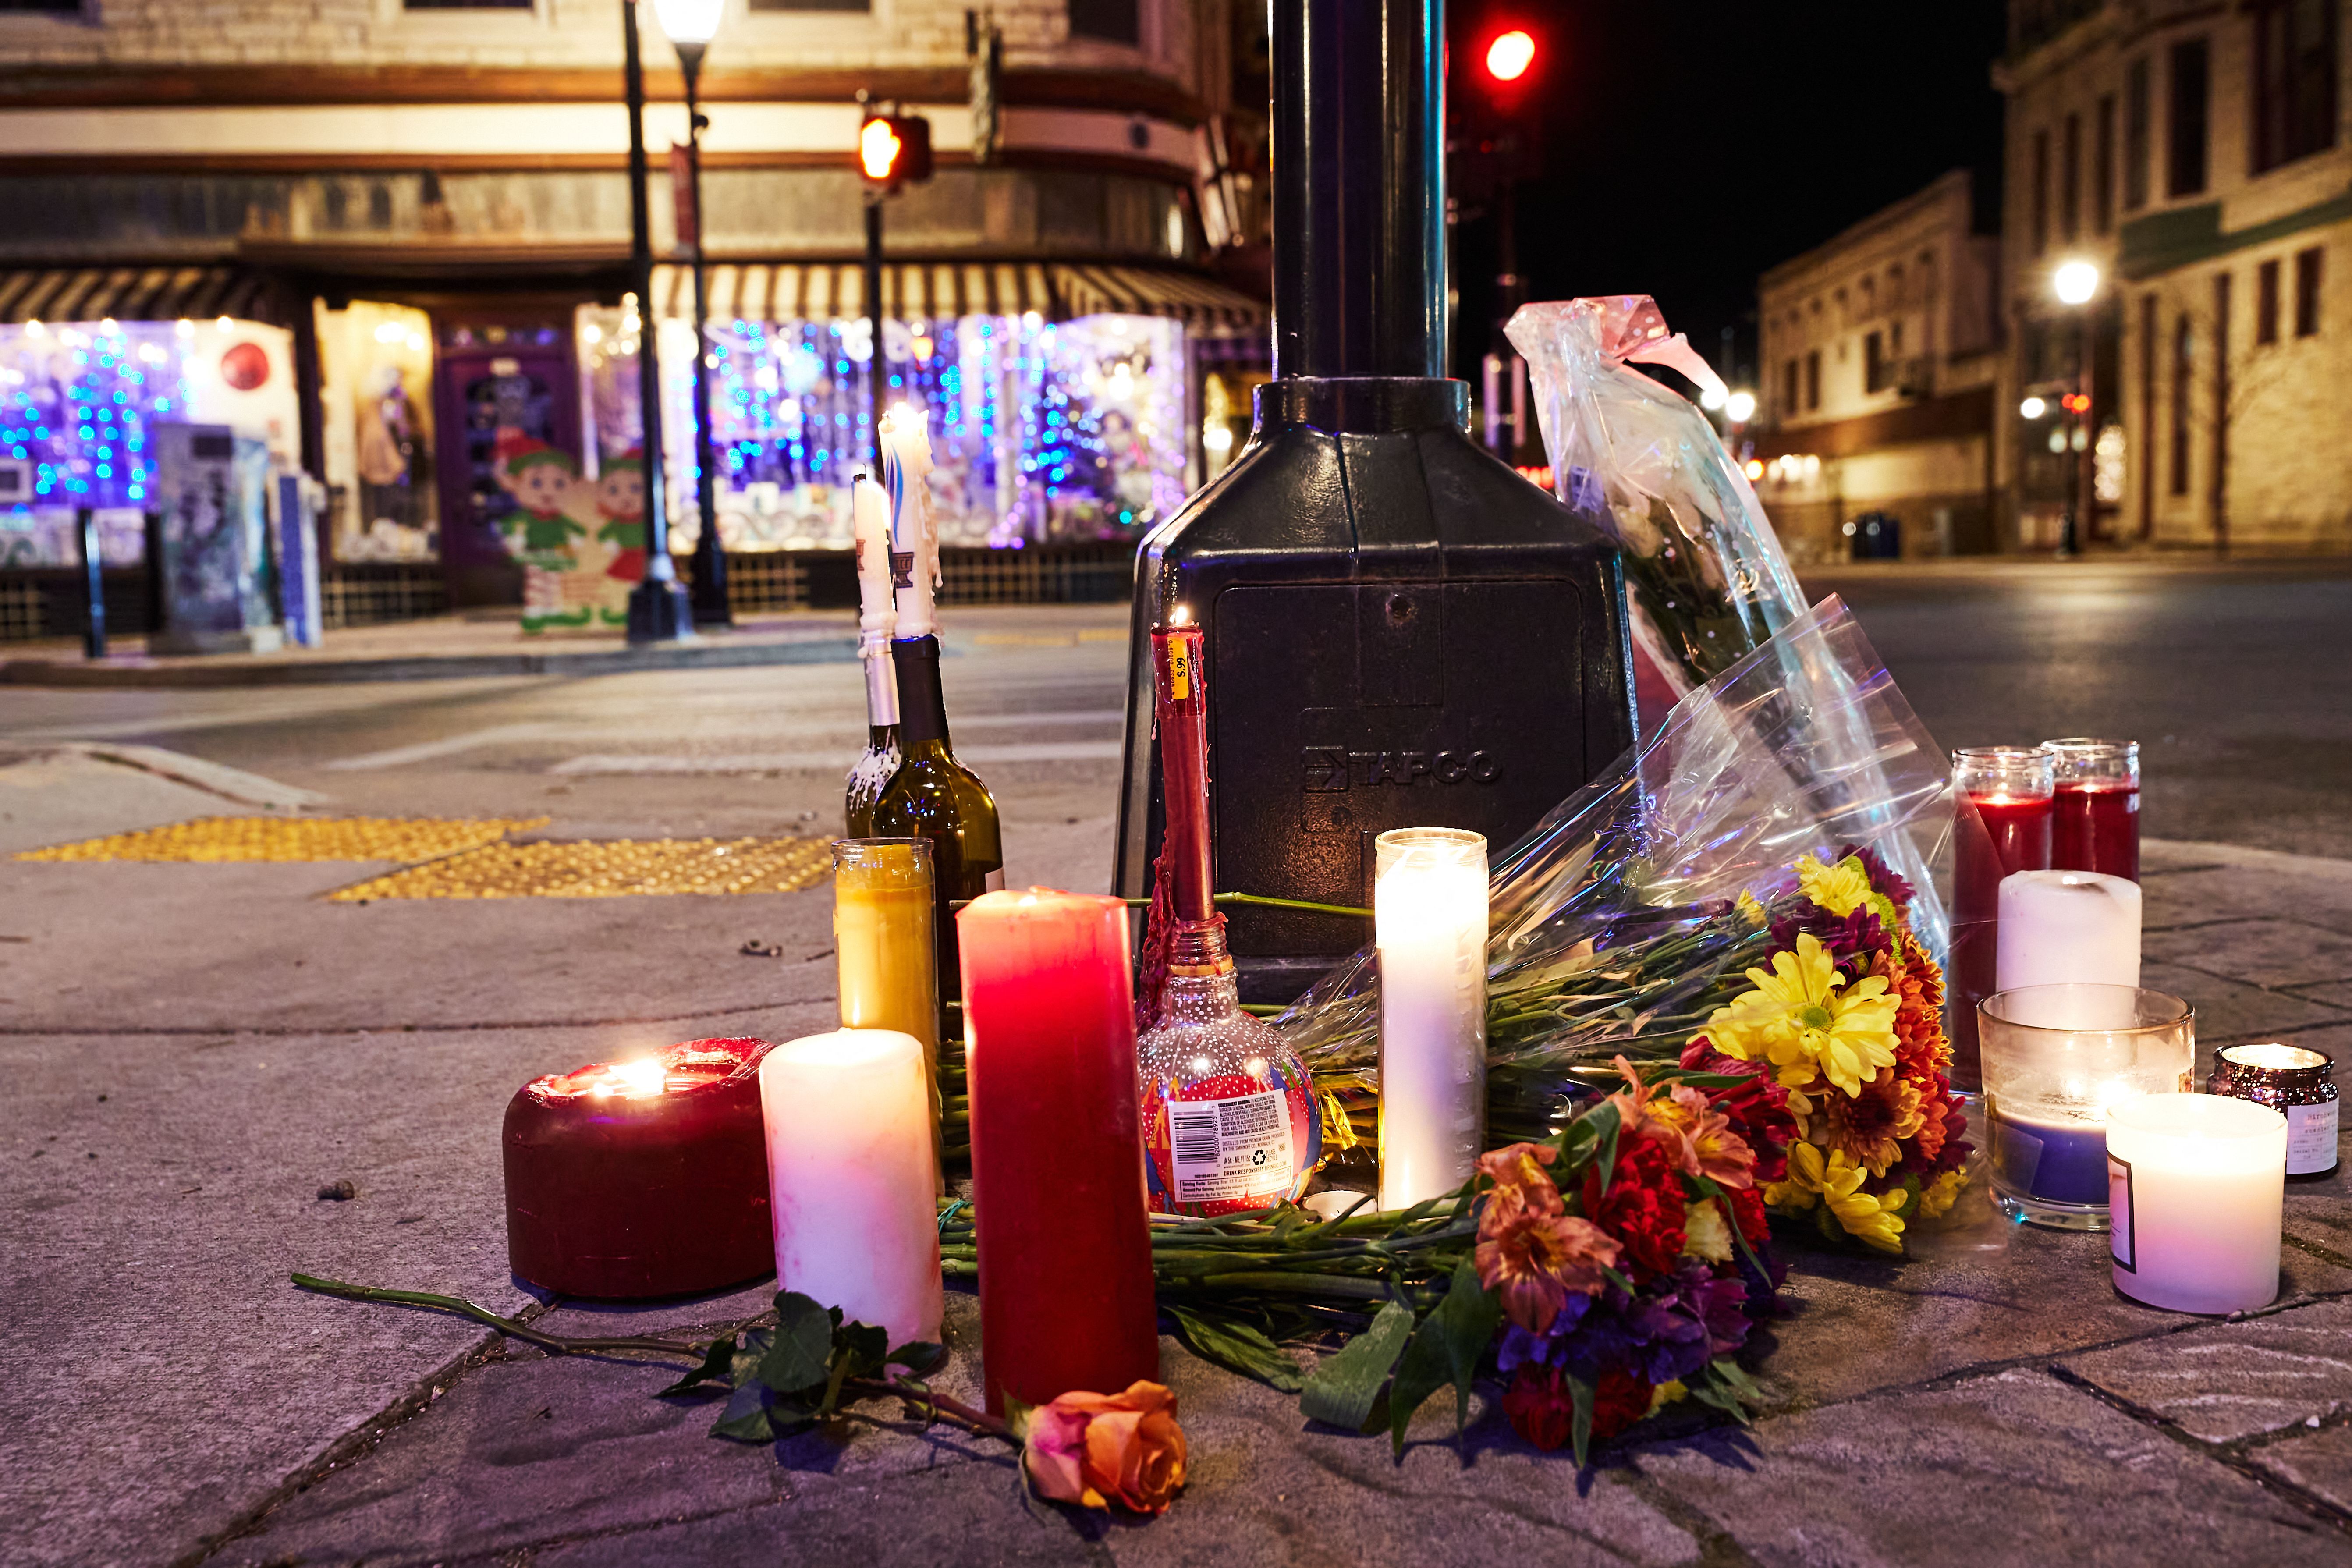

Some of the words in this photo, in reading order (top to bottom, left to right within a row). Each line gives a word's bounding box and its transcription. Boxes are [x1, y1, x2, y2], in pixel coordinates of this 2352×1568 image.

[1176, 657, 1186, 677] $.99
[1348, 750, 1503, 786] TAPCO
[1266, 1154, 1277, 1163] RECYCLE
[1238, 1167, 1264, 1175] RESPONSIBLY
